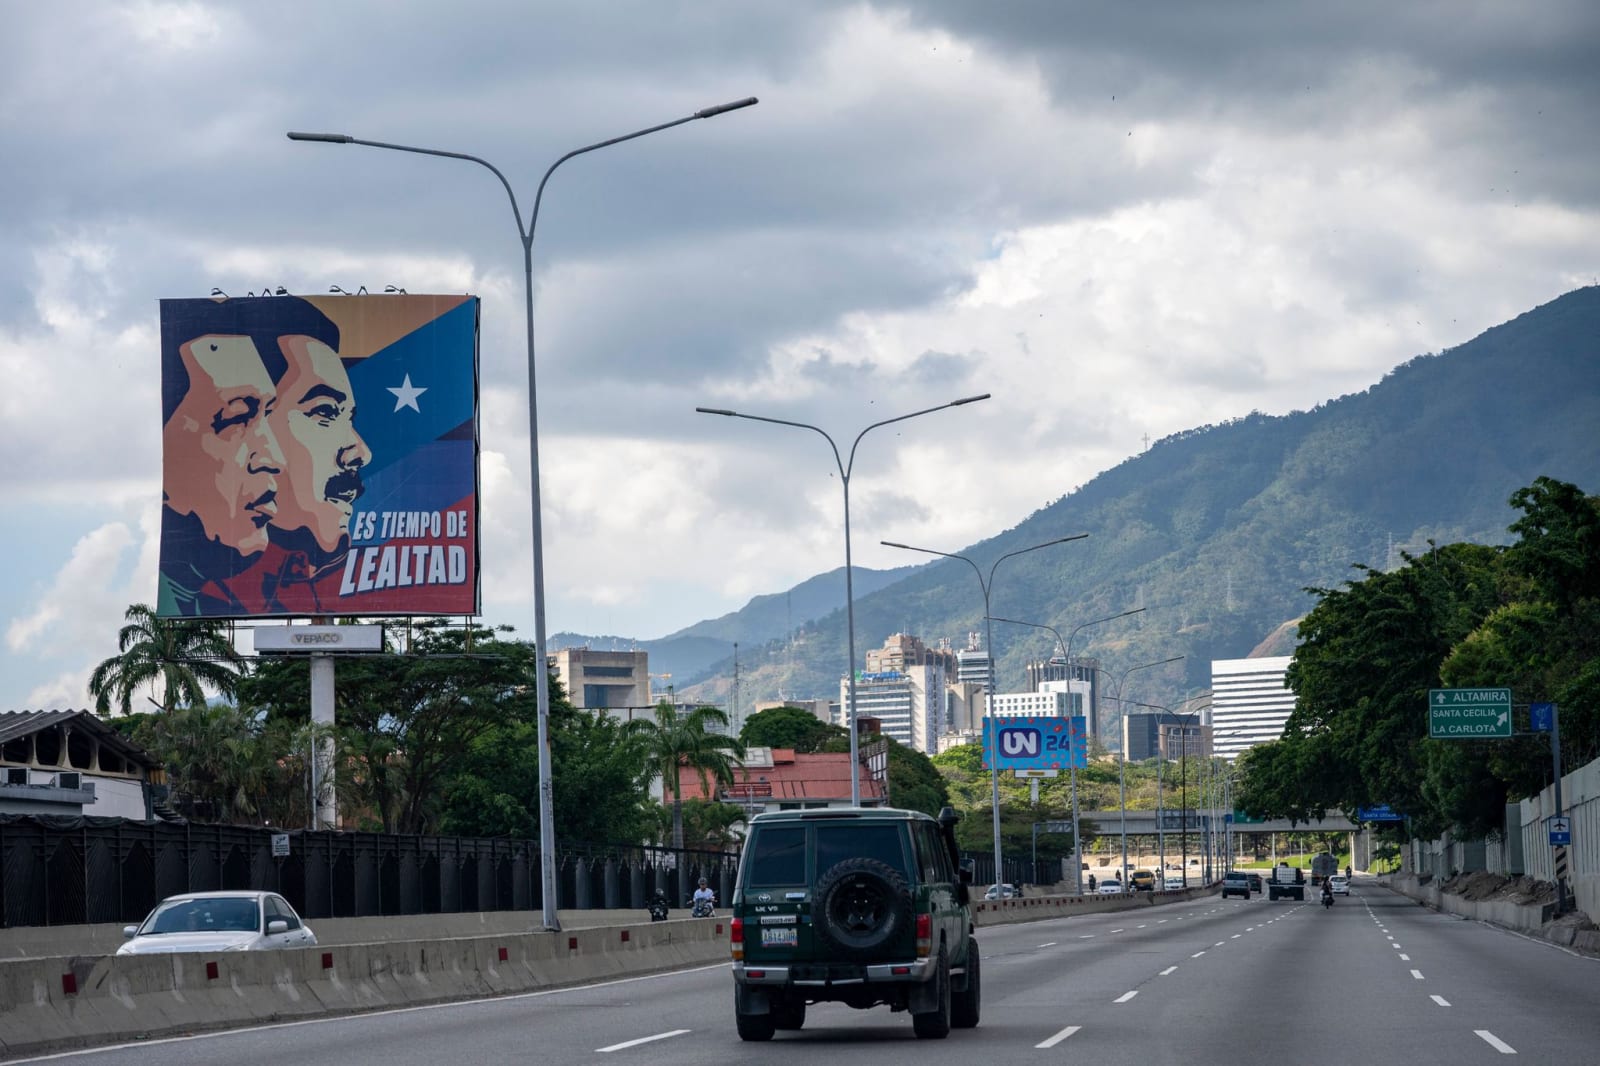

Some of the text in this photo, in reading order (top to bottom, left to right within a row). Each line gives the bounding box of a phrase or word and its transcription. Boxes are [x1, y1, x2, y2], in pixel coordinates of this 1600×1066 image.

[352, 510, 467, 541] ES TIEMPO DE
[339, 545, 466, 596] LEALTAD
[294, 633, 340, 643] VEPACO
[1453, 692, 1508, 702] ALTAMIRA
[1433, 709, 1497, 718] SANTA CECILIA
[1432, 724, 1497, 733] LA CARLOTA
[1003, 732, 1070, 754] UN 24
